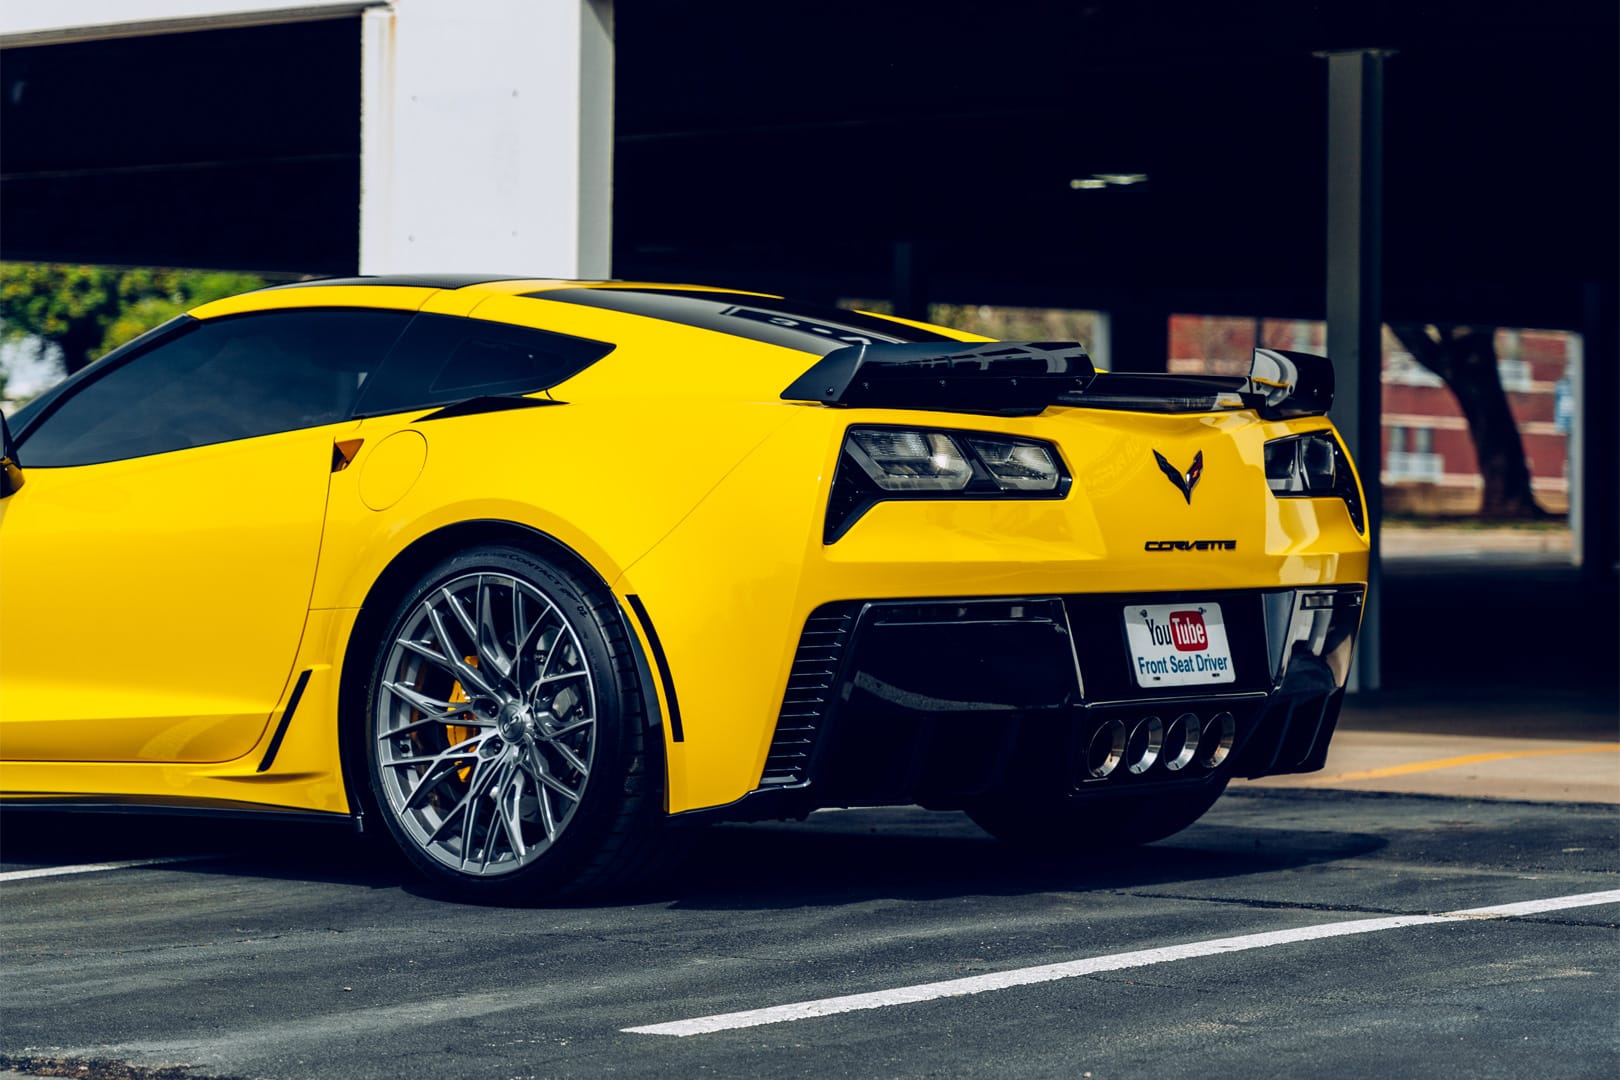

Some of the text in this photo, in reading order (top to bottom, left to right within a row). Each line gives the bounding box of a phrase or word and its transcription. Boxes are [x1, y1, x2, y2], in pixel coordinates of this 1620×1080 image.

[1144, 540, 1237, 551] CORVETTE
[1145, 617, 1205, 646] YouTube
[1138, 653, 1228, 675] Front Seat Driver
